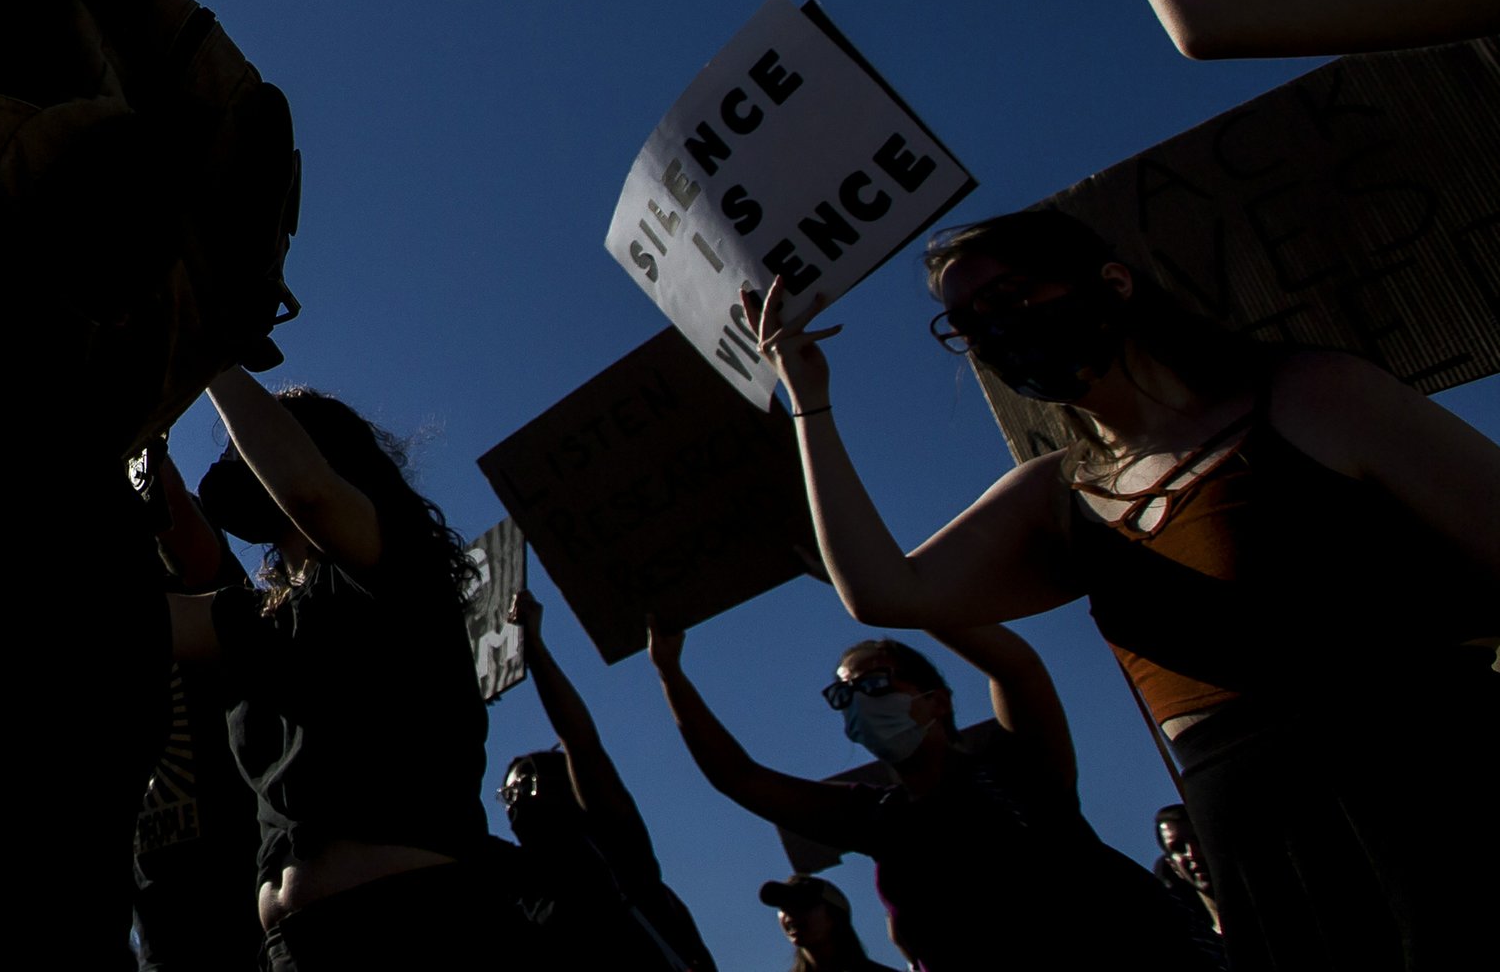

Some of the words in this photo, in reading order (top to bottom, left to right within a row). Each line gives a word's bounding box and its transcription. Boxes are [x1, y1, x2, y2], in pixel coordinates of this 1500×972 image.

[630, 49, 803, 283] SILENCE
[692, 184, 763, 274] IS
[500, 367, 679, 511] LISTEN
